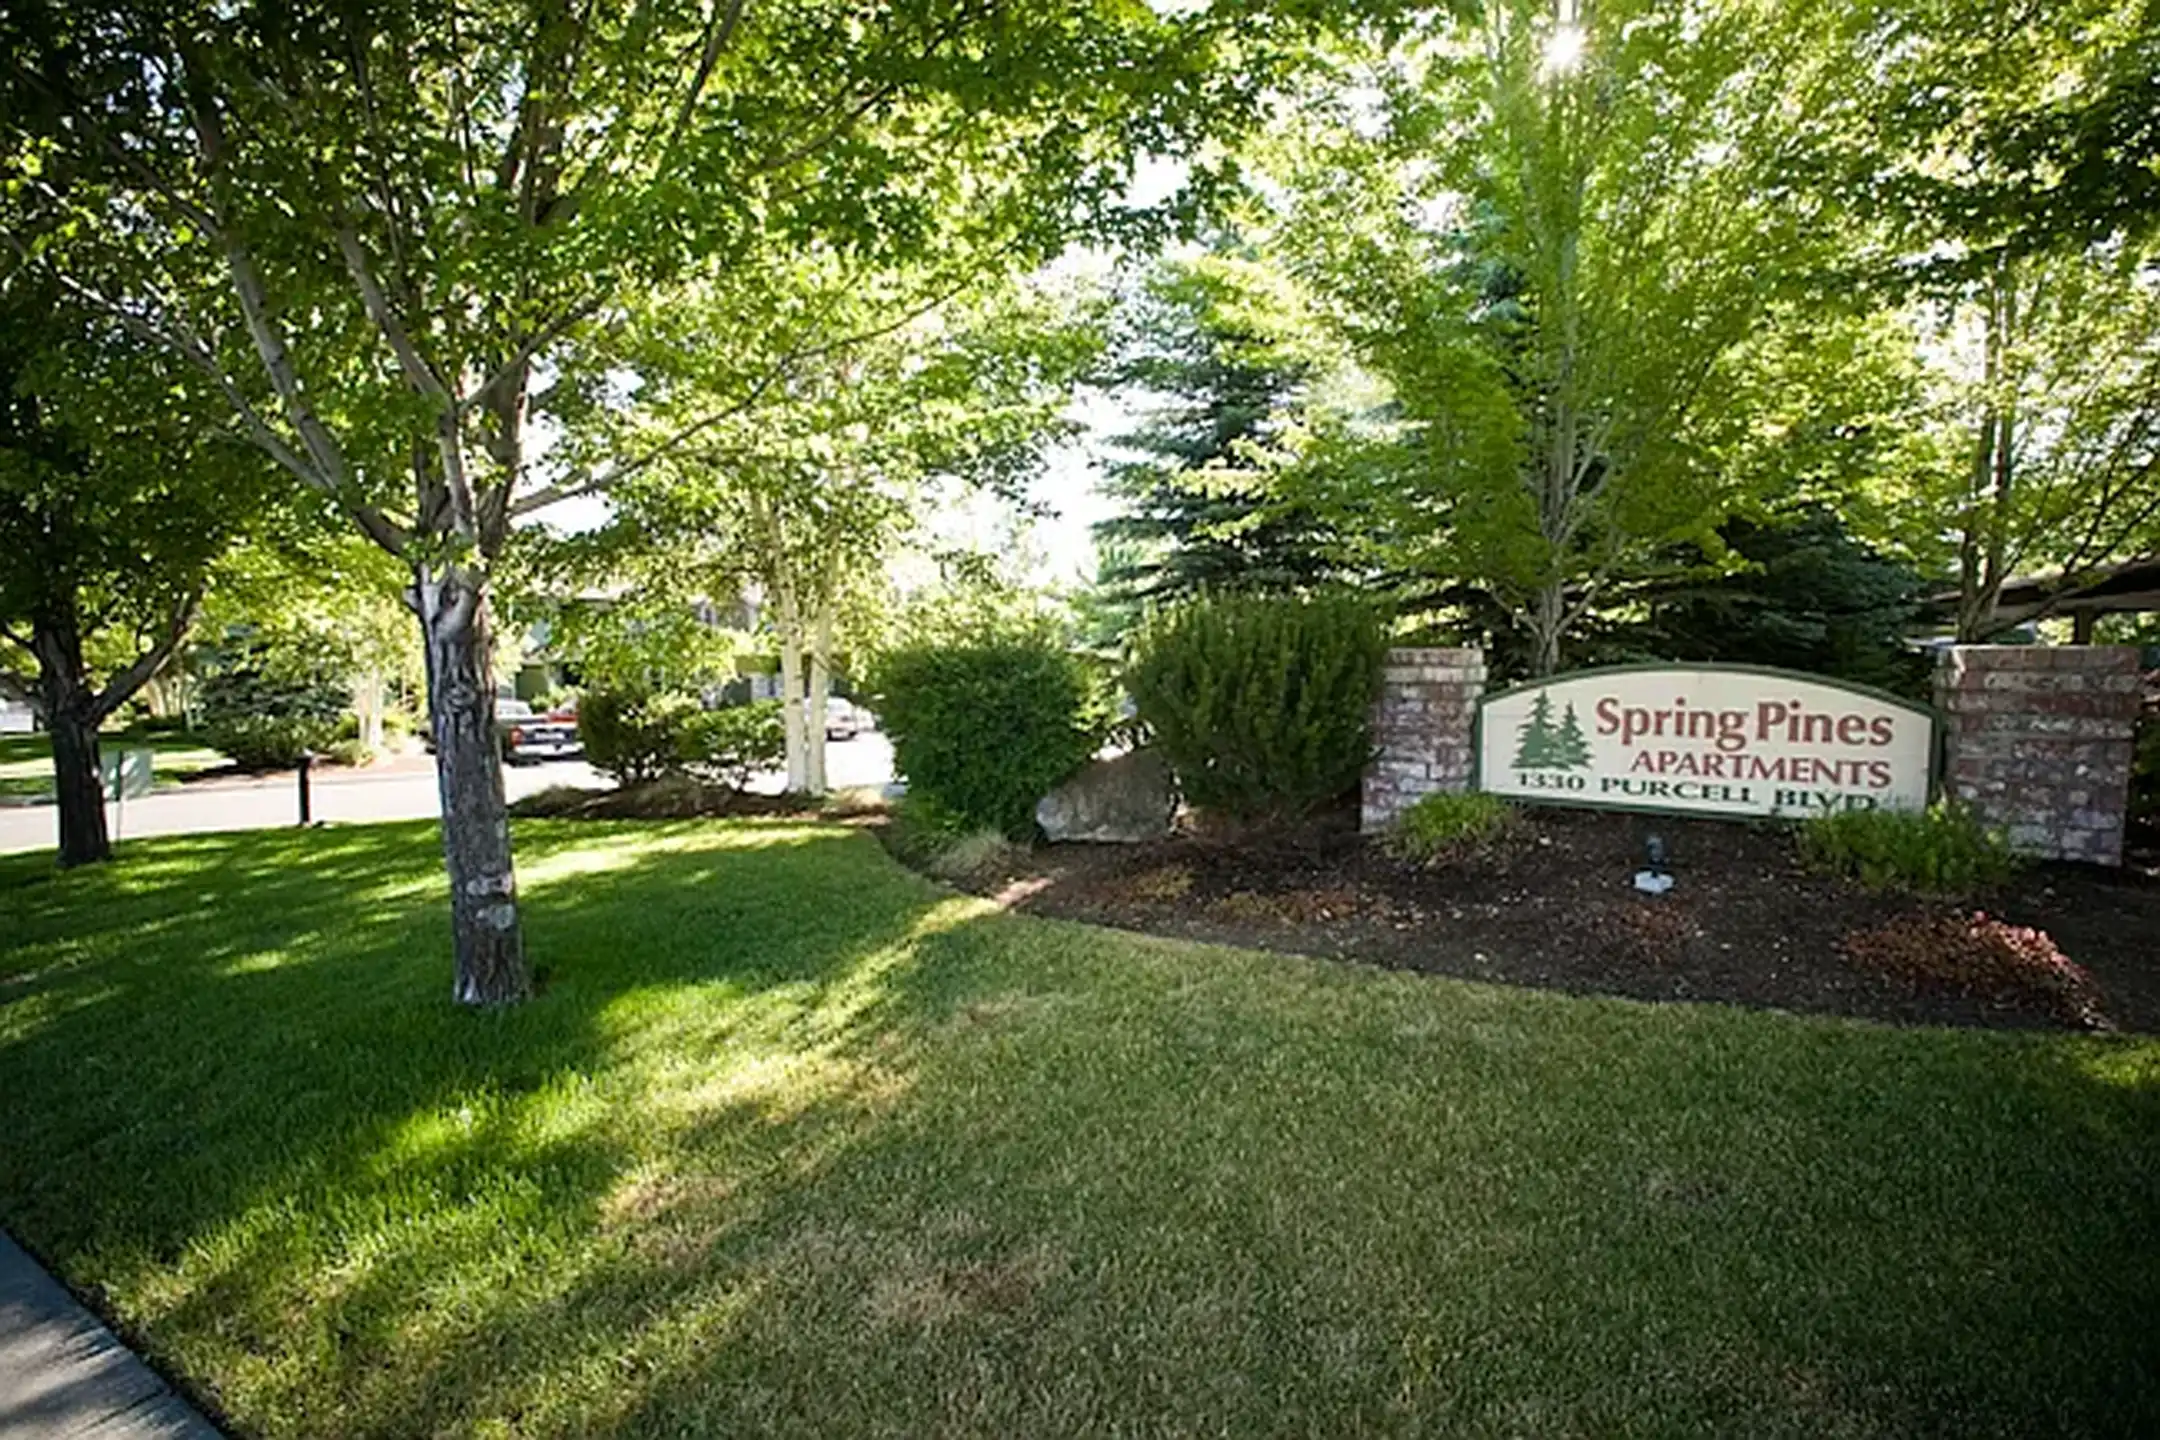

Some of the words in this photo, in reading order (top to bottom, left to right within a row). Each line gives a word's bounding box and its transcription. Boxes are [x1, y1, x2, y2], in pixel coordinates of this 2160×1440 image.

[1596, 697, 1749, 751] Spring
[1757, 700, 1894, 747] Pines
[1630, 749, 1893, 789] APARTMENTS
[1519, 772, 1586, 792] 1330
[1601, 777, 1759, 805] PURCELL
[1774, 789, 1878, 814] BLVD
